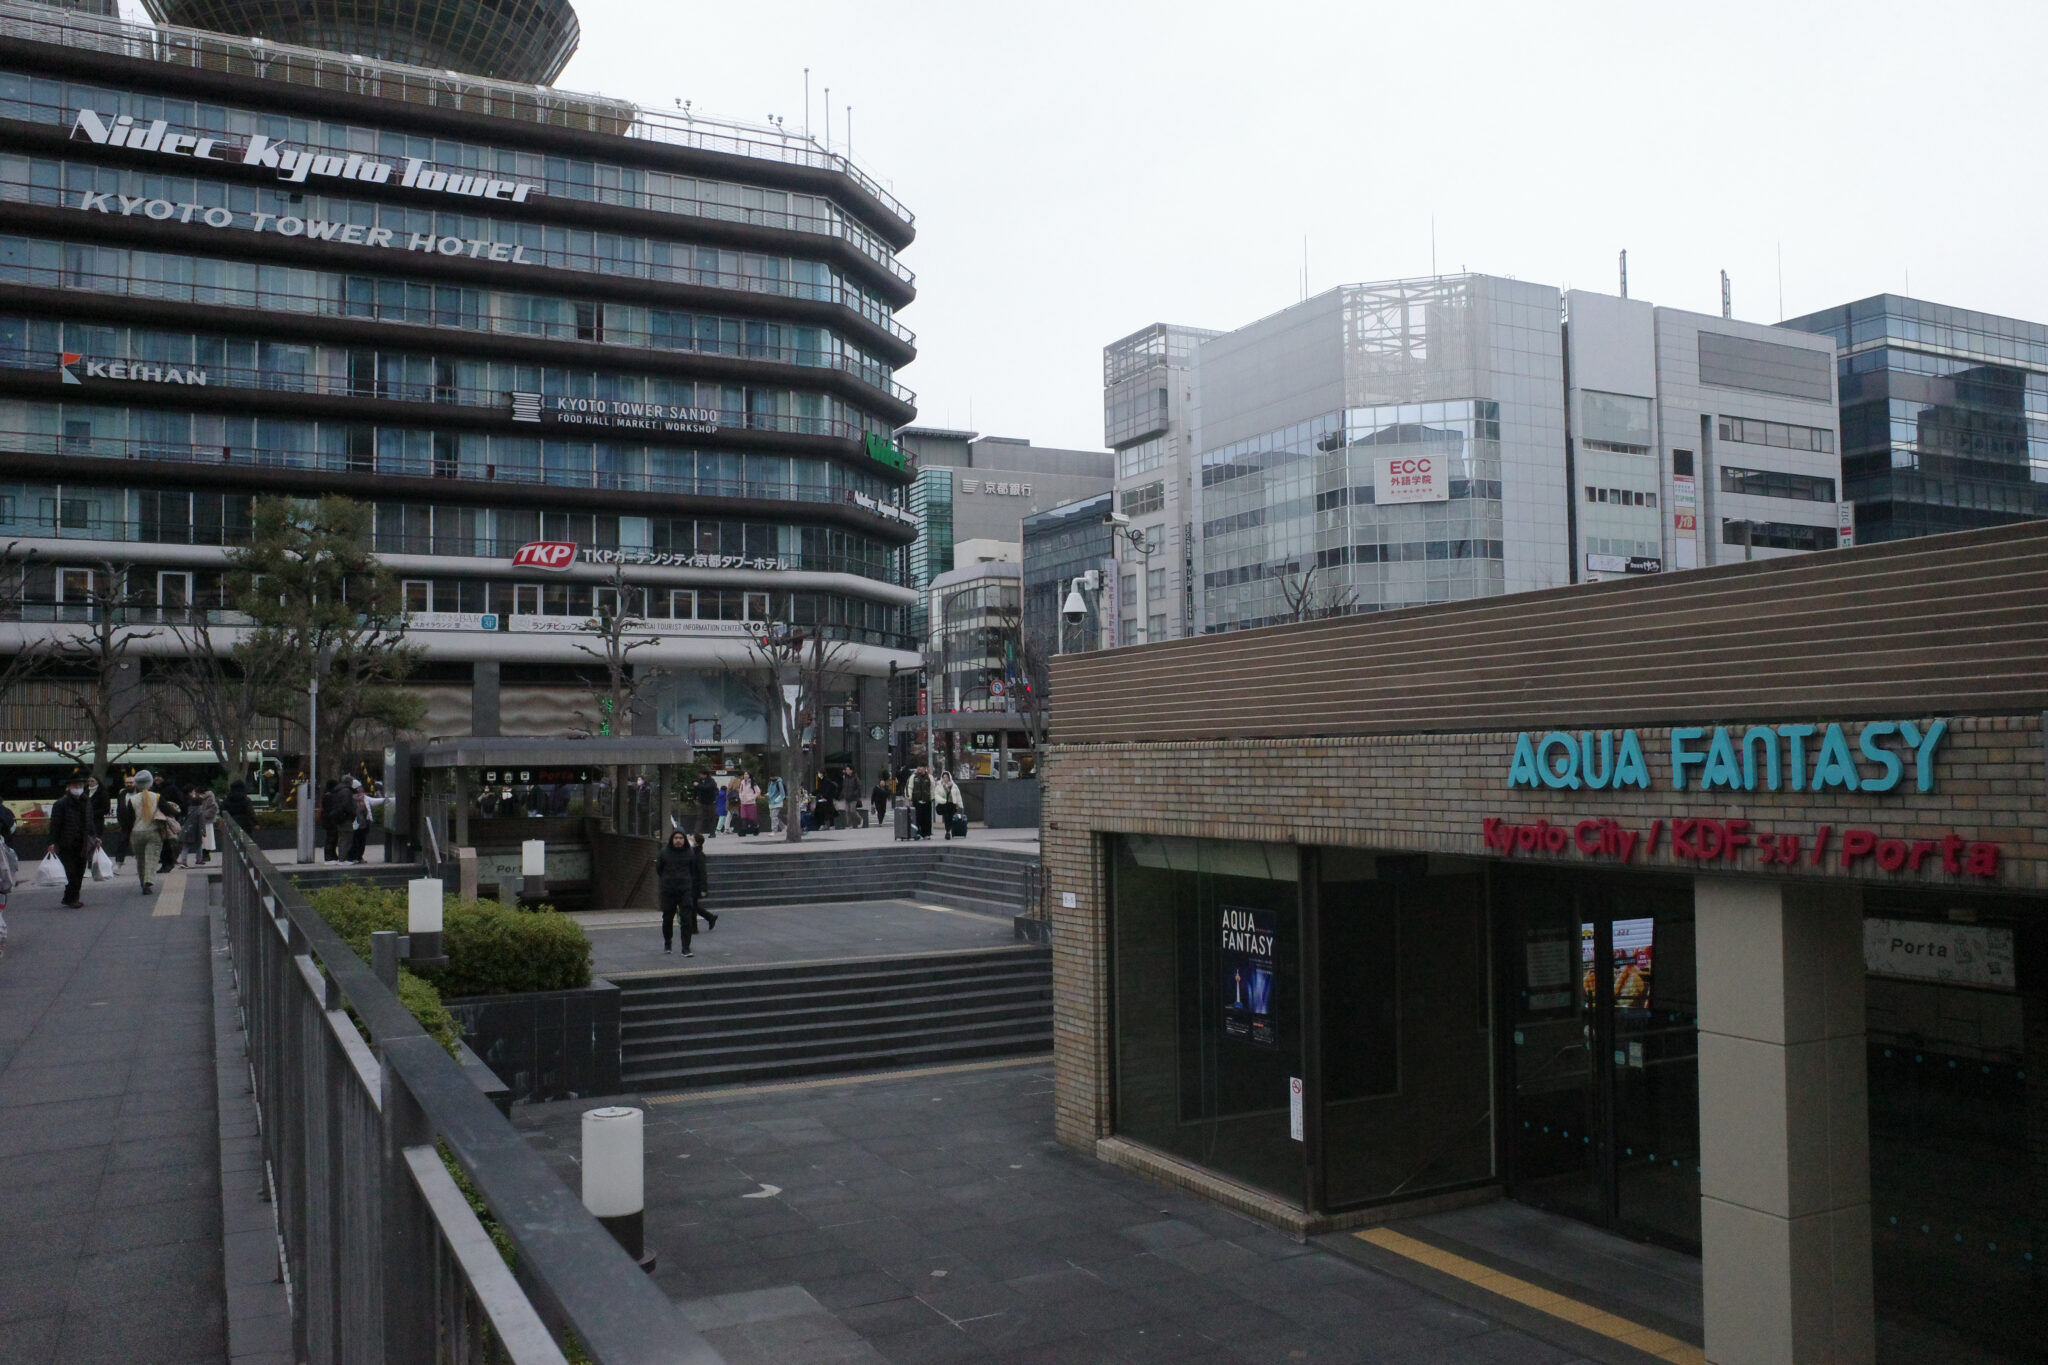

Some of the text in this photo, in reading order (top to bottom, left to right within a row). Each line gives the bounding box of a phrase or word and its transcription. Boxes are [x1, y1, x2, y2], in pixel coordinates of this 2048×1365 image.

[70, 108, 541, 203] Nidec Kyoto Tower
[81, 190, 532, 265] KYOTO TOWER HOTEL
[87, 361, 207, 386] KEIHAN
[557, 396, 718, 423] KYOTO TOWER SANDO
[557, 413, 719, 435] FOOD HALL MARKET WORKSHOP
[1390, 458, 1432, 475] ECC
[984, 481, 1033, 497] 京都銀行
[1390, 474, 1433, 487] 外語学院
[1679, 515, 1693, 529] JTB
[520, 545, 572, 564] TKP
[657, 623, 682, 631] TOURIST
[683, 623, 720, 632] INFORMATION
[721, 624, 742, 632] CENTER
[1508, 720, 1948, 792] AQUA FANTASY
[1482, 817, 1567, 856] Kyoto
[1574, 818, 1639, 863] City
[1645, 819, 1663, 855] /
[1810, 825, 1832, 866] /
[1841, 829, 2000, 877] Porta
[496, 864, 523, 873] Port
[1222, 909, 1255, 932] AQUA
[1222, 930, 1273, 957] FANTASY
[1891, 938, 1948, 958] Porta
